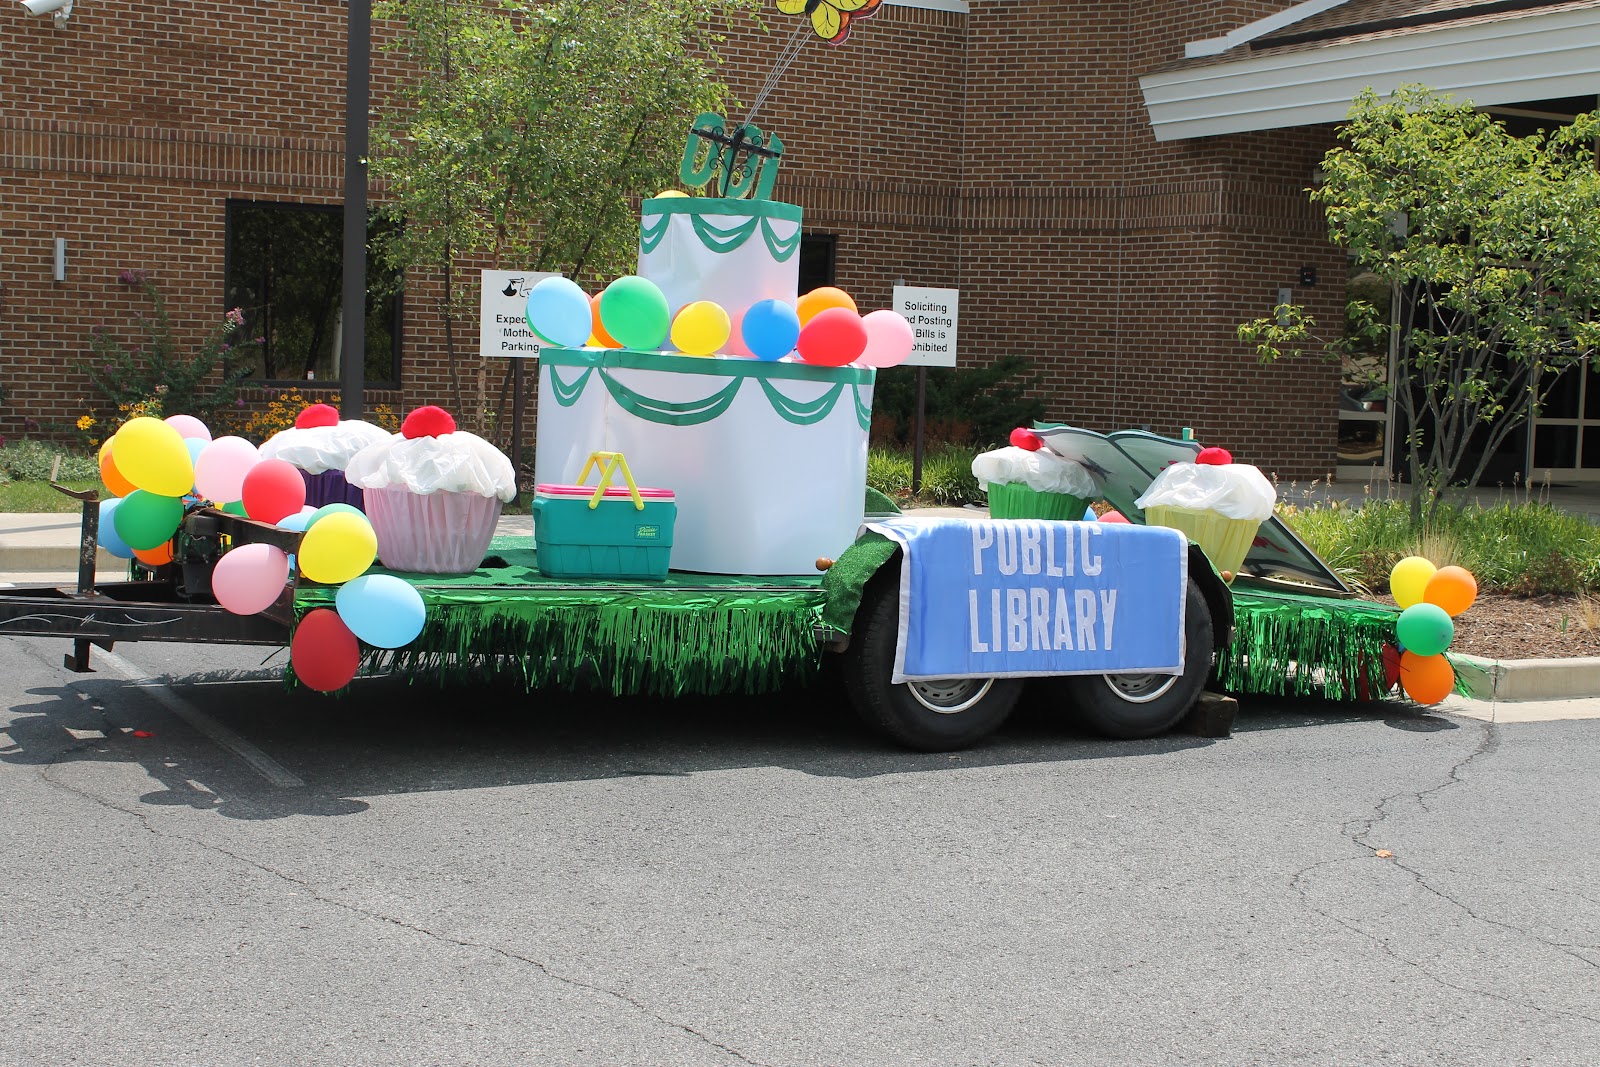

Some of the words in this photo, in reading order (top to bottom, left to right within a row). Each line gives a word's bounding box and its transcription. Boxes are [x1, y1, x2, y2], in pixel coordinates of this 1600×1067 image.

[904, 301, 947, 314] Soliciting
[904, 315, 916, 324] nd
[918, 315, 952, 328] Posting
[915, 328, 936, 339] Bills
[938, 329, 946, 339] is
[501, 341, 540, 354] Parking
[911, 342, 948, 352] ohibited
[970, 521, 1103, 577] PUBLIC
[968, 587, 1117, 653] LIBRARY
